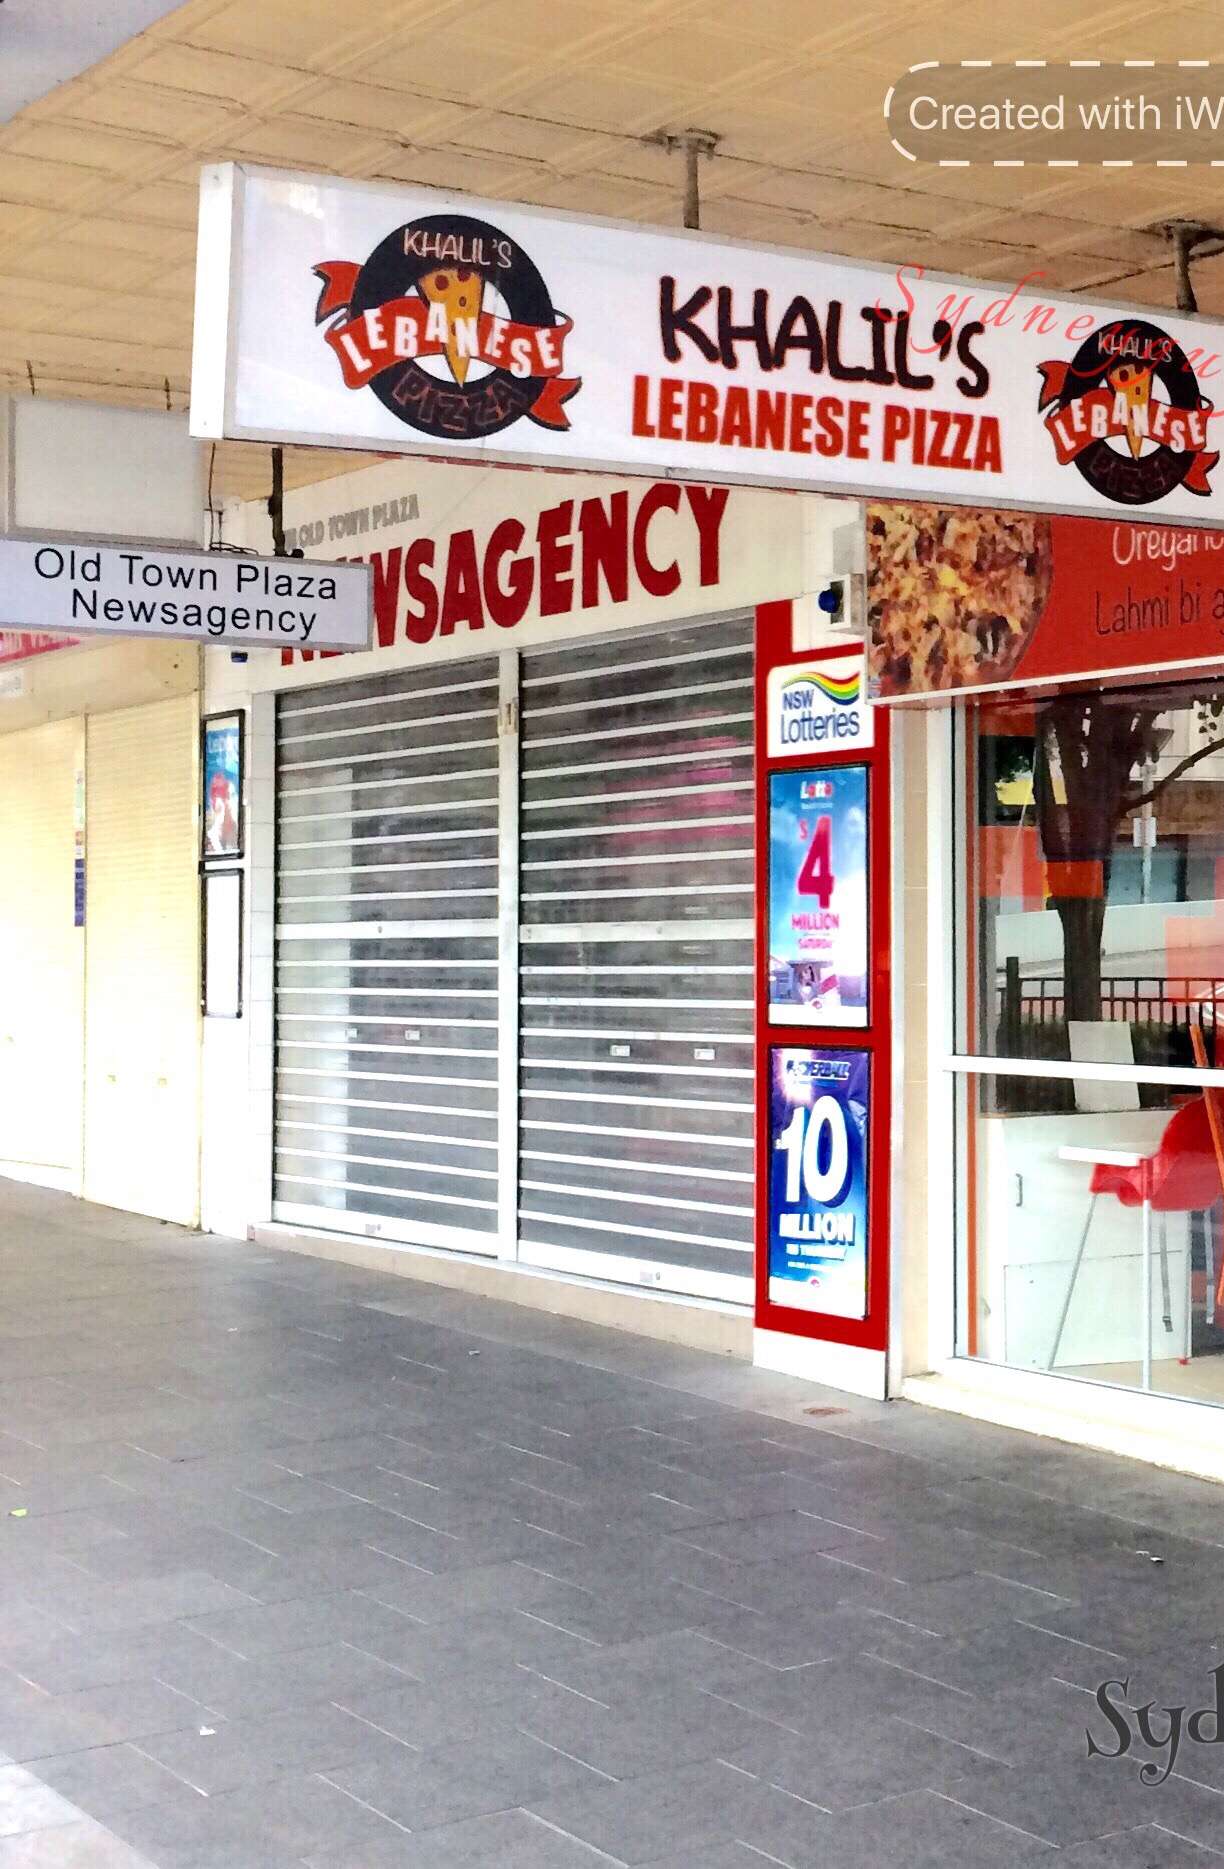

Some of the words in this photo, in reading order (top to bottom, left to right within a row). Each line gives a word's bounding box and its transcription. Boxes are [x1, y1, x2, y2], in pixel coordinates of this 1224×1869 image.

[404, 228, 512, 268] KHALIL'S
[340, 302, 561, 378] LEBANESE
[660, 275, 990, 399] KHALIL'S
[392, 368, 523, 433] PIZZA
[632, 374, 870, 461] LEBANESE
[883, 407, 1004, 474] PIZZA
[1055, 392, 1205, 453] LEBANESE
[328, 507, 369, 541] TOWN
[372, 493, 420, 530] PLAZA
[34, 547, 102, 583] Old
[120, 554, 218, 592] Town
[236, 564, 339, 601] Plaza
[281, 482, 730, 667] WSAGENCY
[71, 588, 318, 641] Newsagency
[1096, 586, 1169, 635] Lahmi
[1180, 578, 1201, 625] bi
[780, 708, 860, 745] Lotteries
[783, 689, 815, 710] NSW
